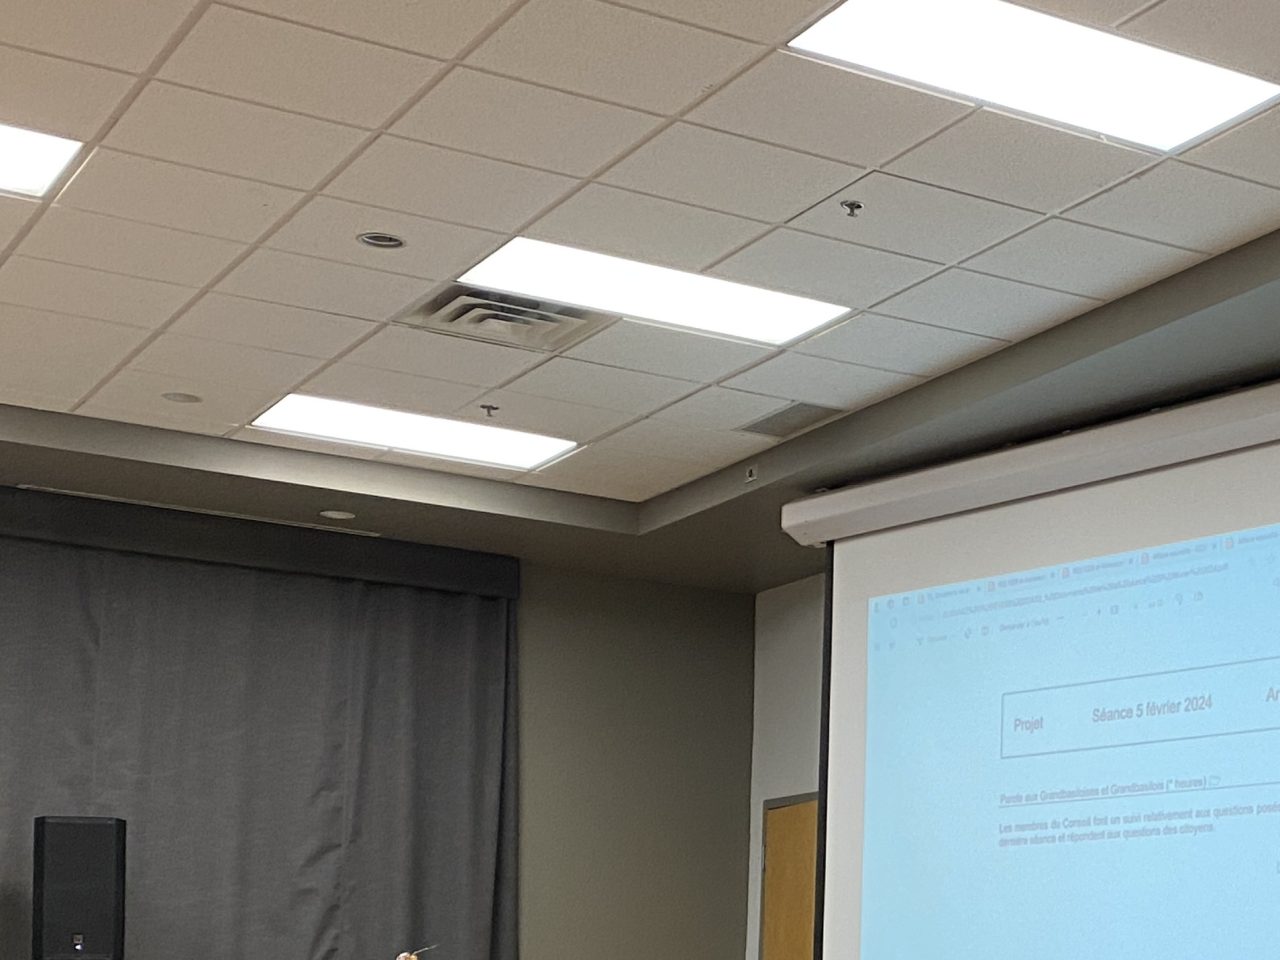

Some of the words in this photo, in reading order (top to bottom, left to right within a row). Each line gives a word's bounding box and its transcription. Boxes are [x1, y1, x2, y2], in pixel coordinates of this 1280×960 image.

[1013, 715, 1044, 734] Projet
[1091, 701, 1134, 723] Séance
[1135, 703, 1144, 718] 5
[1145, 698, 1182, 716] février
[1183, 694, 1213, 711] 2024
